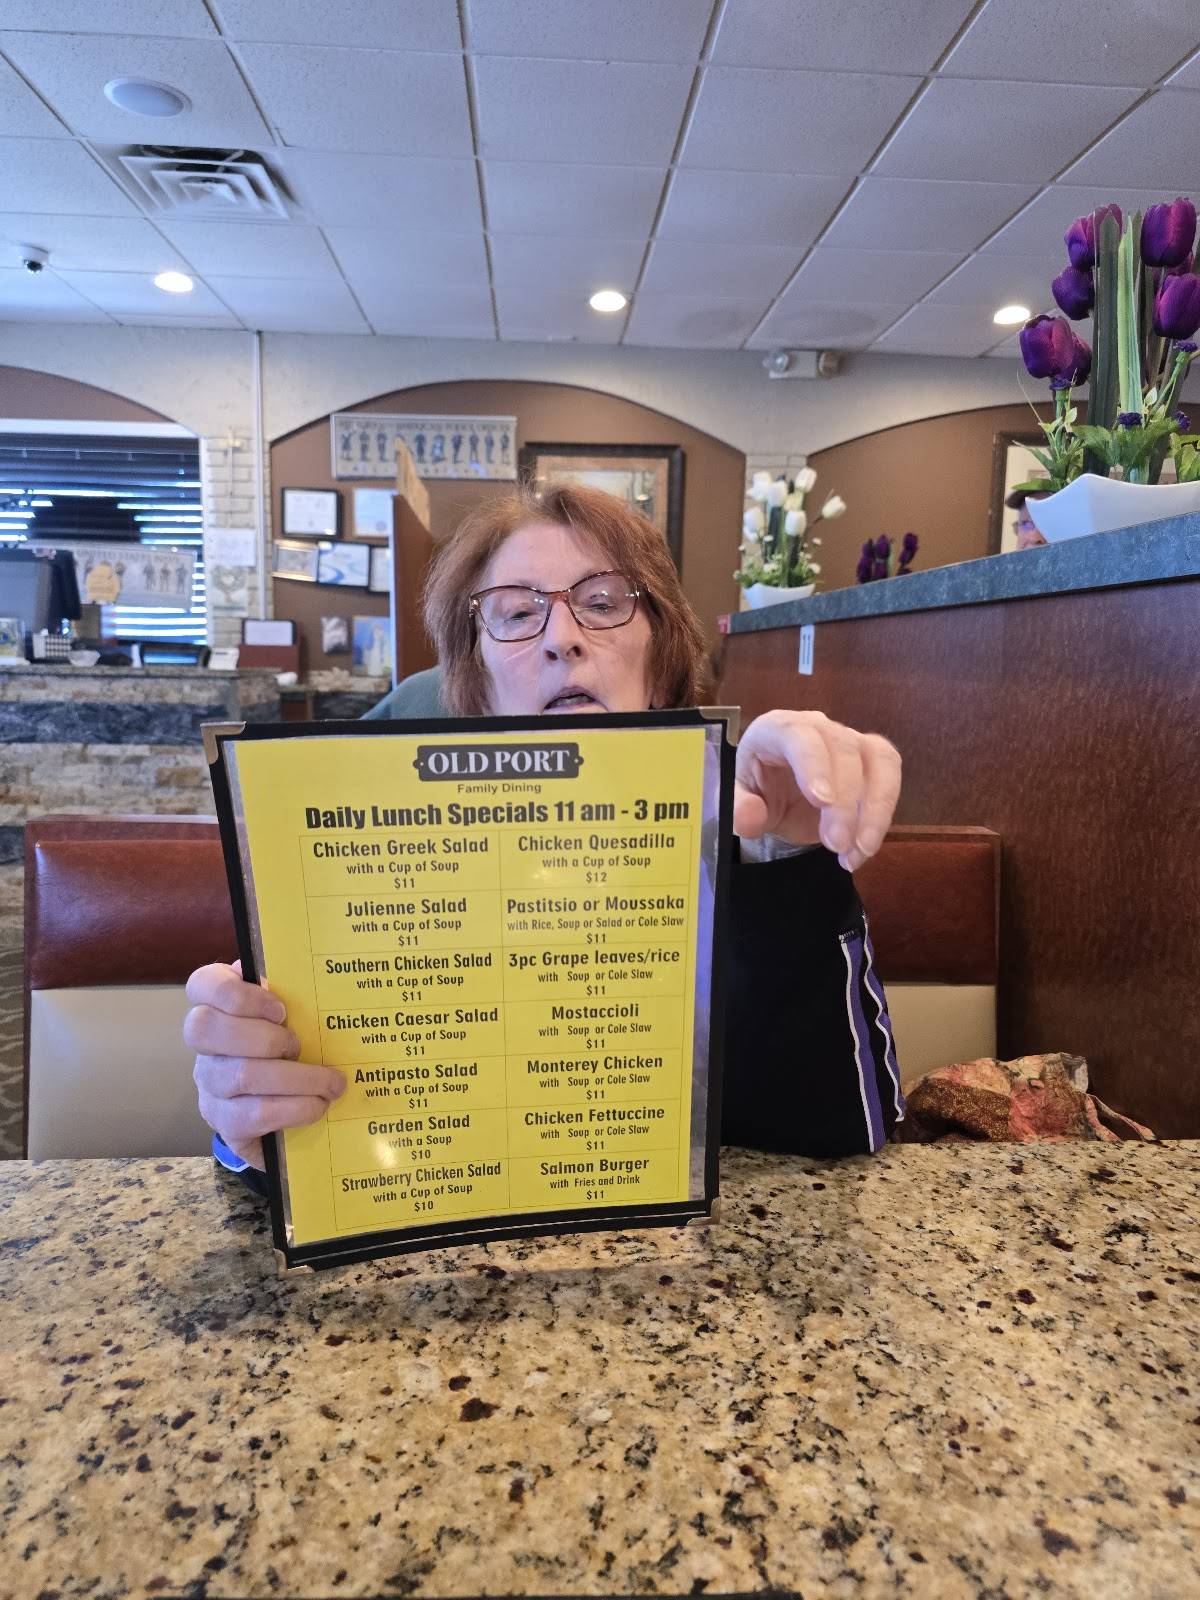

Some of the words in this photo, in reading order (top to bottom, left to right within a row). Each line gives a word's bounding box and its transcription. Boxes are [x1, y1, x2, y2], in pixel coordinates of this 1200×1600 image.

[428, 751, 489, 774] OLD
[494, 750, 570, 773] PORT
[457, 783, 498, 795] Family
[502, 782, 541, 794] Dining
[305, 806, 366, 830] Daily
[371, 804, 442, 827] Lunch
[447, 801, 549, 826] Specials
[554, 801, 574, 822] 11
[581, 803, 615, 821] am
[634, 799, 648, 821] 3
[654, 802, 689, 822] pm
[313, 841, 381, 858] Chicken
[387, 839, 437, 855] Greek
[442, 837, 488, 854] Salad
[518, 835, 582, 851] Chicken
[589, 833, 675, 851] Quesadilla
[346, 862, 374, 874] with
[377, 864, 385, 873] a
[388, 861, 411, 875] Cup
[415, 860, 427, 872] of
[430, 860, 459, 873] Soup
[542, 856, 568, 868] with
[572, 859, 579, 867] a
[583, 855, 604, 869] Cup
[608, 855, 620, 867] of
[623, 855, 651, 869] Soup
[394, 877, 415, 890] $11
[586, 871, 607, 884] $12
[345, 901, 416, 917] Julienne
[421, 897, 467, 914] Salad
[507, 897, 577, 914] Pastitsio
[583, 900, 600, 911] or
[606, 895, 684, 911] Moussaka
[352, 921, 378, 933] with
[382, 923, 389, 931] a
[393, 920, 415, 933] Cup
[418, 919, 430, 930] of
[434, 918, 462, 931] Soup
[507, 919, 528, 931] with
[531, 919, 554, 930] Rice,
[557, 918, 580, 931] Soup
[583, 920, 593, 929] or
[596, 917, 622, 928] Salad
[625, 919, 636, 927] or
[638, 916, 659, 927] Cole
[661, 915, 684, 927] Slaw
[398, 935, 418, 947] $11
[586, 932, 606, 945] $11
[325, 958, 390, 974] Southern
[394, 955, 449, 971] Chicken
[453, 952, 492, 968] Salad
[509, 953, 537, 969] 3pc
[542, 951, 589, 968] Grape
[595, 948, 680, 964] leaves/rice
[356, 977, 383, 989] with
[386, 979, 393, 988] a
[396, 976, 419, 989] Cup
[422, 975, 433, 986] of
[436, 974, 464, 987] Soup
[537, 971, 559, 983] with
[567, 970, 590, 983] Soup
[595, 972, 606, 981] or
[608, 969, 628, 980] Cole
[631, 968, 653, 979] Slaw
[402, 990, 422, 1003] $11
[586, 984, 605, 997] $11
[326, 1014, 389, 1030] Chicken
[394, 1012, 450, 1027] Caesar
[454, 1007, 498, 1024] Salad
[552, 1003, 639, 1020] Mostaccioli
[361, 1032, 387, 1044] with
[390, 1034, 397, 1043] a
[400, 1031, 422, 1044] Cup
[425, 1030, 436, 1041] of
[439, 1029, 466, 1041] Soup
[538, 1026, 559, 1037] with
[567, 1025, 590, 1037] Soup
[595, 1026, 605, 1034] or
[607, 1023, 627, 1034] Cole
[629, 1022, 652, 1033] Slaw
[405, 1045, 425, 1057] $11
[586, 1038, 605, 1050] $11
[527, 1060, 599, 1074] Monterey
[603, 1055, 663, 1070] Chicken
[355, 1066, 430, 1084] Antipasto
[435, 1062, 478, 1078] Salad
[539, 1077, 559, 1088] with
[567, 1076, 590, 1088] Soup
[594, 1077, 605, 1085] or
[607, 1074, 627, 1085] Cole
[629, 1073, 651, 1084] Slaw
[365, 1086, 390, 1098] with
[393, 1087, 401, 1096] a
[404, 1084, 425, 1096] Cup
[428, 1082, 439, 1093] of
[442, 1082, 469, 1094] Soup
[586, 1089, 605, 1101] $11
[408, 1097, 428, 1110] $11
[524, 1111, 583, 1126] Chicken
[589, 1106, 665, 1122] Fettuccine
[368, 1118, 423, 1135] Garden
[428, 1114, 470, 1130] Salad
[540, 1129, 560, 1140] with
[567, 1128, 590, 1139] Soup
[594, 1128, 604, 1137] or
[606, 1125, 626, 1136] Cole
[628, 1124, 650, 1135] Slaw
[388, 1137, 413, 1148] with
[416, 1138, 423, 1146] a
[425, 1134, 452, 1146] Soup
[586, 1140, 604, 1152] $11
[411, 1149, 431, 1161] $10
[540, 1161, 594, 1176] Salmon
[599, 1158, 649, 1174] Burger
[341, 1173, 412, 1192] Strawberry
[415, 1166, 464, 1183] Chicken
[467, 1161, 501, 1178] Salad
[549, 1178, 569, 1189] with
[574, 1177, 596, 1188] Fries
[598, 1175, 614, 1186] and
[616, 1174, 640, 1185] Drink
[373, 1191, 397, 1203] with
[400, 1191, 407, 1200] a
[410, 1188, 431, 1199] Cup
[433, 1185, 445, 1196] of
[447, 1184, 473, 1195] Soup
[586, 1189, 604, 1201] $11
[414, 1200, 434, 1213] $10
